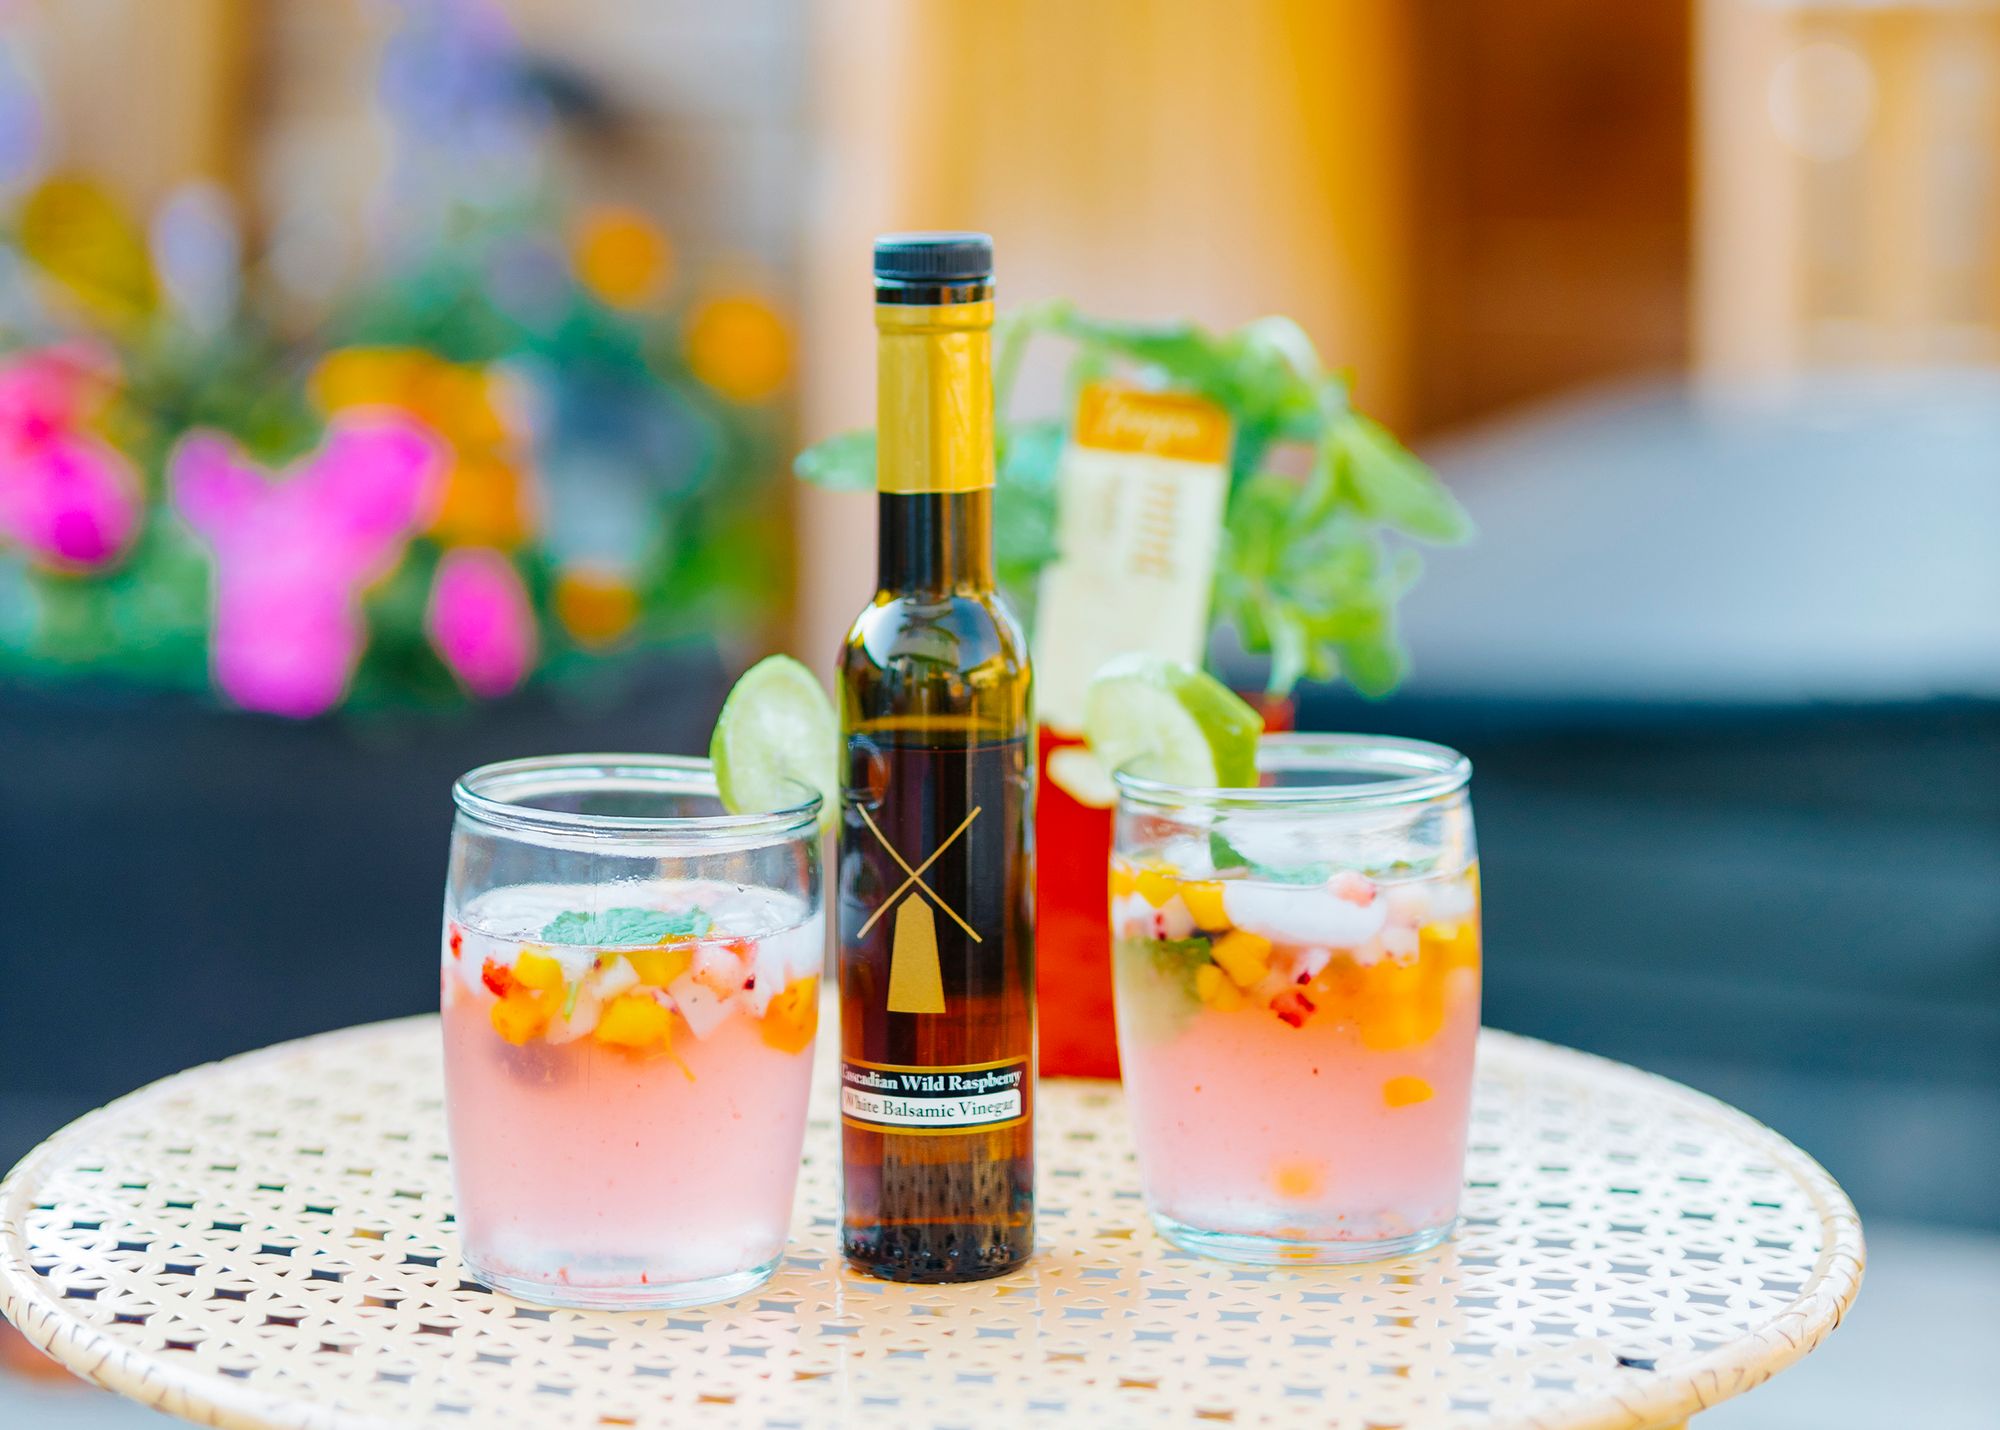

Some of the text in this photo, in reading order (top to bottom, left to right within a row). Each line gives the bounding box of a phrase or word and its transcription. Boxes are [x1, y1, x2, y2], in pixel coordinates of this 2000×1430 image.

[900, 1075, 945, 1091] Wild
[948, 1070, 1022, 1093] Raspberry
[845, 1092, 1014, 1117] White Balsamic Vinegar
